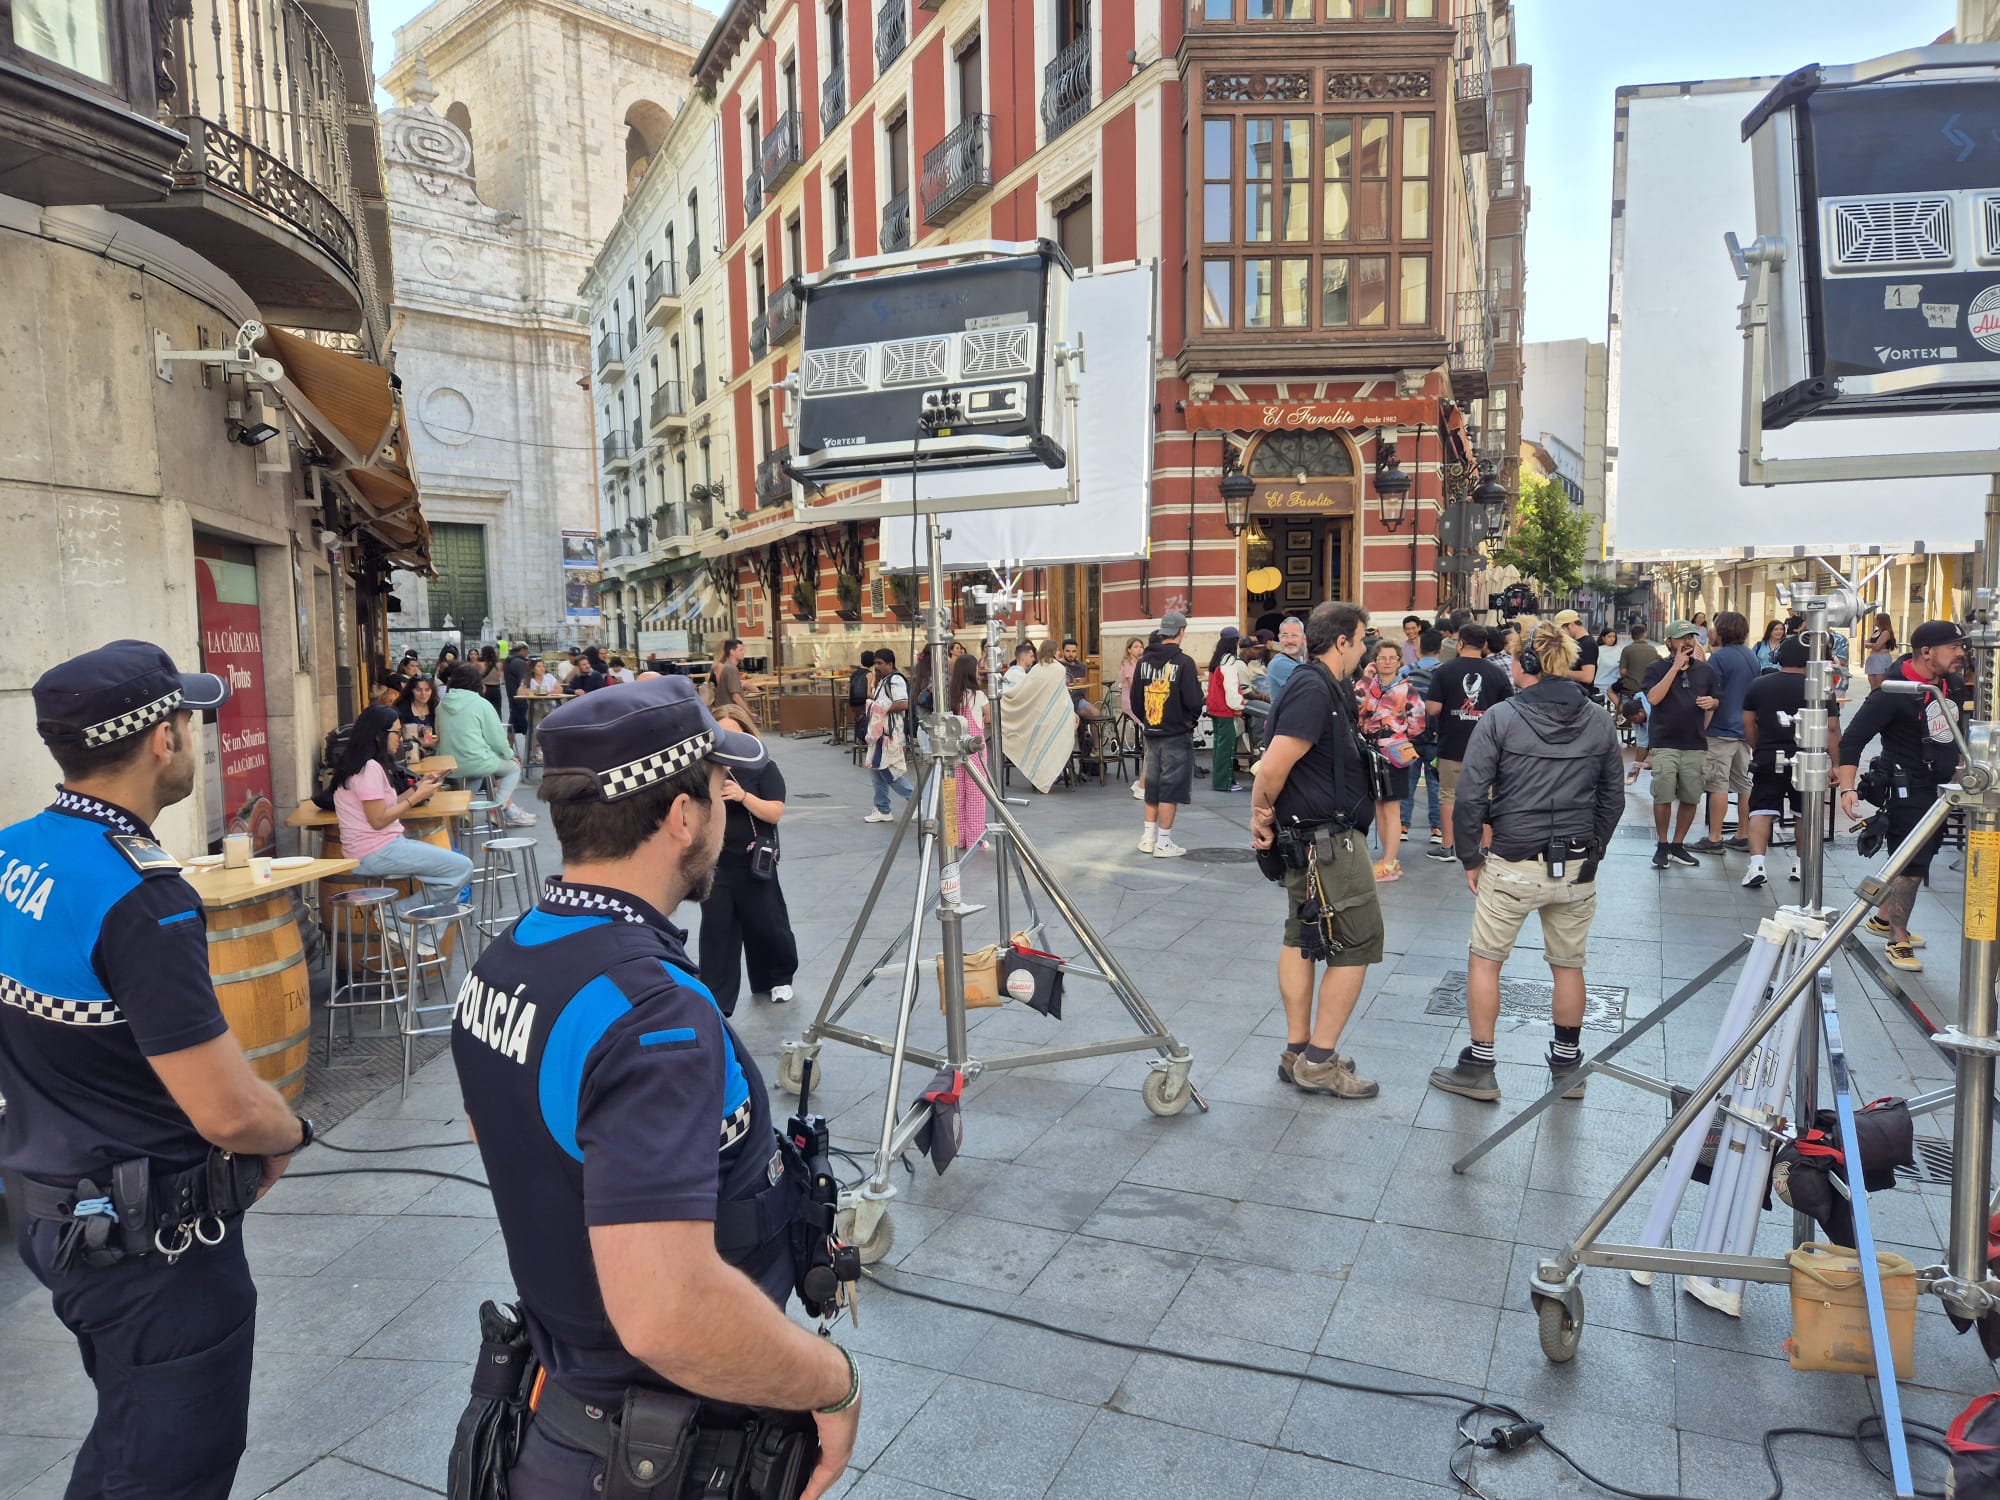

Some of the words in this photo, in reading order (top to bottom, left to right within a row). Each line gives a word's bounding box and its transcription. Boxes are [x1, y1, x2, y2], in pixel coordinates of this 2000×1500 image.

[1893, 287, 1903, 307] 1
[1874, 346, 1938, 364] VORTEX
[1263, 406, 1284, 426] El
[1287, 405, 1355, 425] Farolito
[1363, 415, 1381, 424] desde
[823, 437, 856, 449] VORTEX
[1265, 491, 1284, 508] El
[1287, 491, 1335, 507] Farolito
[207, 631, 221, 654] LA
[221, 625, 261, 653] CÁRCAVA
[227, 664, 251, 696] Protos
[221, 732, 232, 753] Sé
[232, 737, 242, 751] un
[234, 759, 242, 773] LA
[0, 849, 55, 921] ICÍA
[452, 969, 537, 1065] POLICÍA
